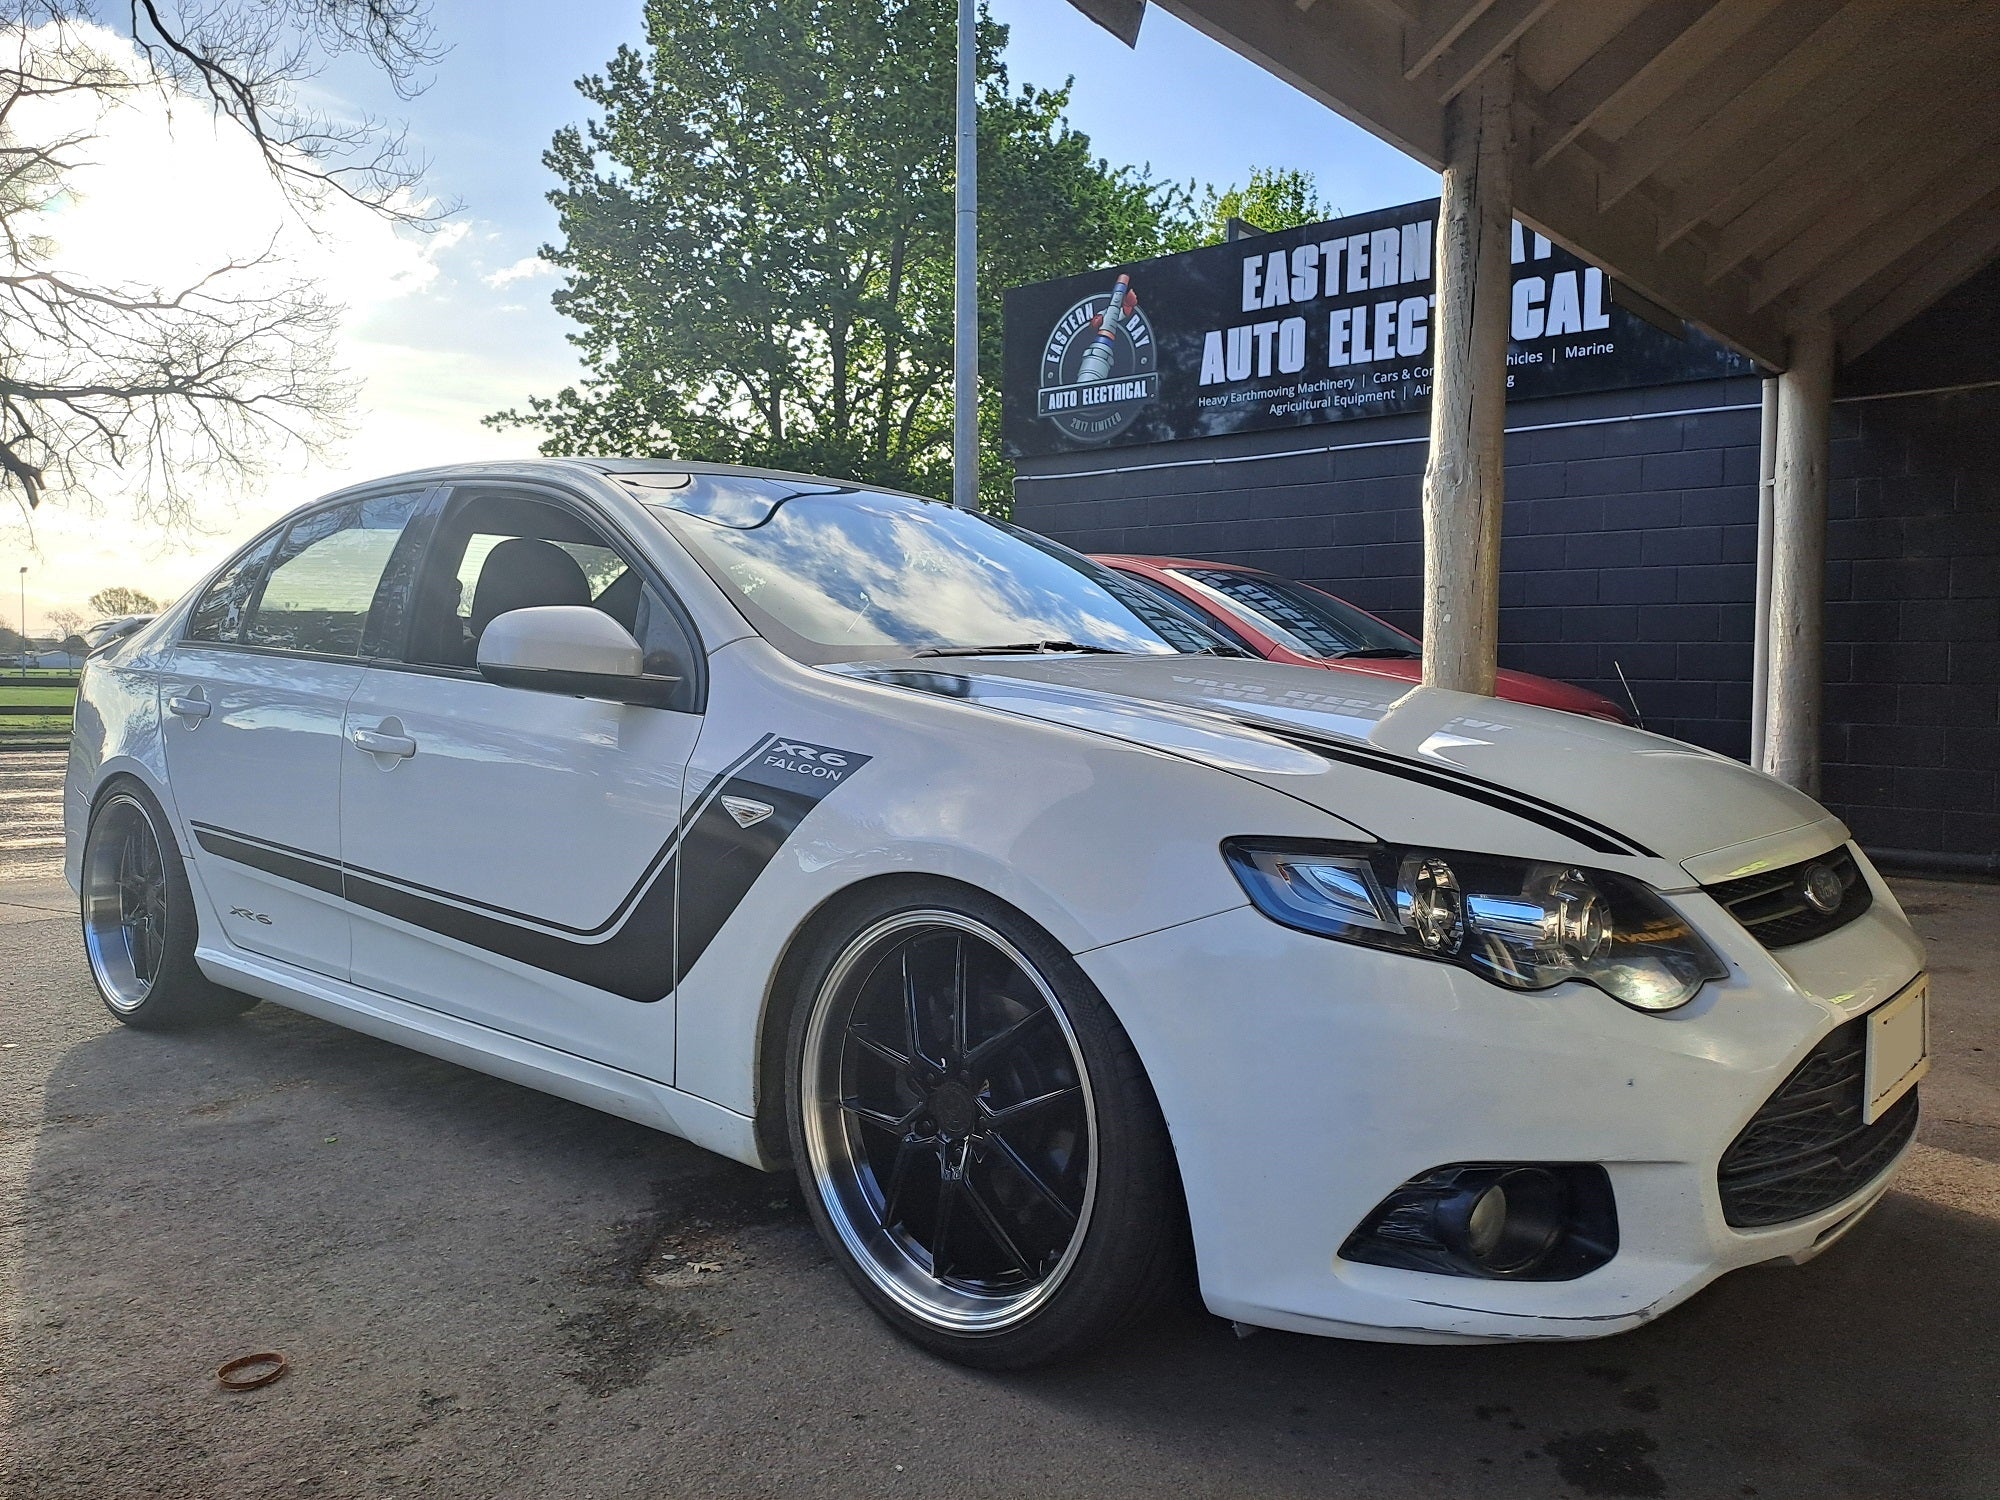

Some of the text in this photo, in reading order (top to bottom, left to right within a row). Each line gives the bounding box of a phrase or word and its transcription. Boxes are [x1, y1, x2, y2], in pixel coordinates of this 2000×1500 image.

[1242, 219, 1433, 313] EASTERN
[1047, 303, 1150, 364] EASTERN BAY
[1199, 272, 1610, 386] AUTO ELECCAL
[1565, 342, 1614, 358] Marine
[1049, 380, 1147, 410] AUTO ELECTRICAL
[1198, 396, 1228, 408] Heavy
[1231, 386, 1295, 403] Earthmoving
[1297, 377, 1355, 394] Machinery
[1373, 371, 1399, 384] Cars
[1401, 368, 1411, 380] &
[1269, 398, 1331, 416] Agricultural
[1334, 388, 1396, 408] Equipment
[1091, 412, 1122, 432] LIMITED
[763, 755, 843, 781] FALCON
[772, 741, 848, 767] XR6
[229, 905, 273, 925] XR6
